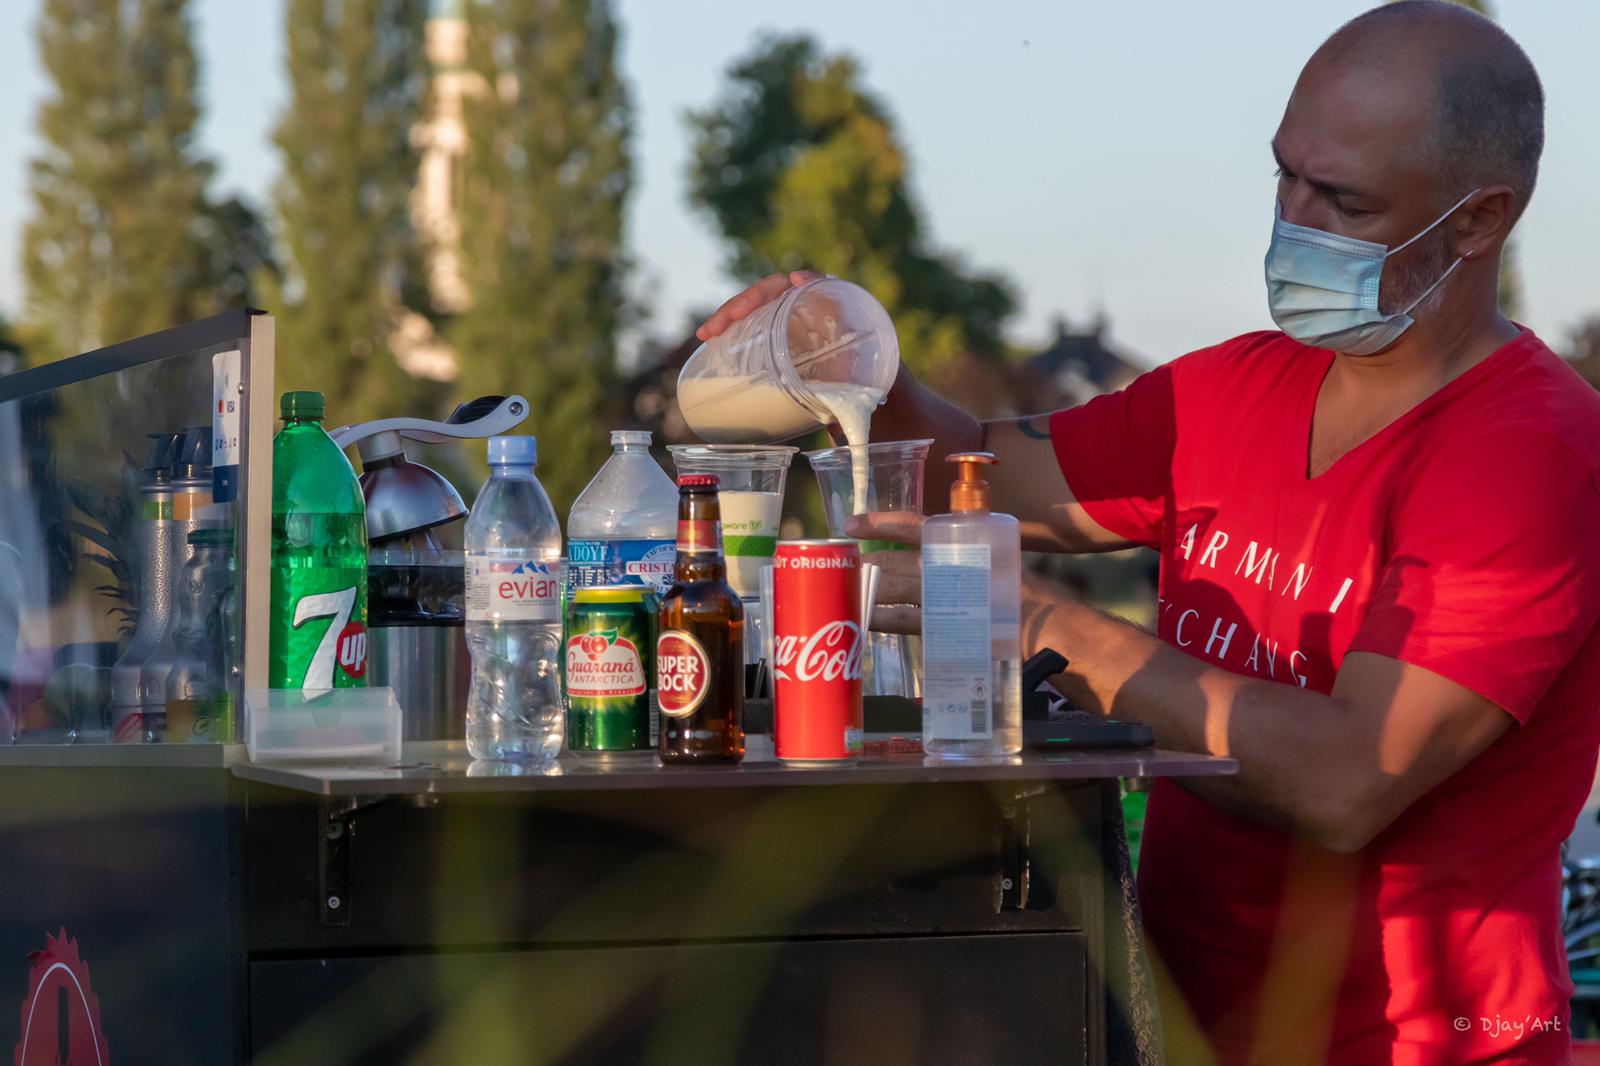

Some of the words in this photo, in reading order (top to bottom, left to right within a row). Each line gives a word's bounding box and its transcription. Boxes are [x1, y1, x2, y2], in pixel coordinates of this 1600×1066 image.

[790, 556, 855, 569] ORIGINAL
[499, 576, 558, 600] evian
[567, 651, 635, 681] Guaraná
[574, 674, 635, 684] ANTARCTICA
